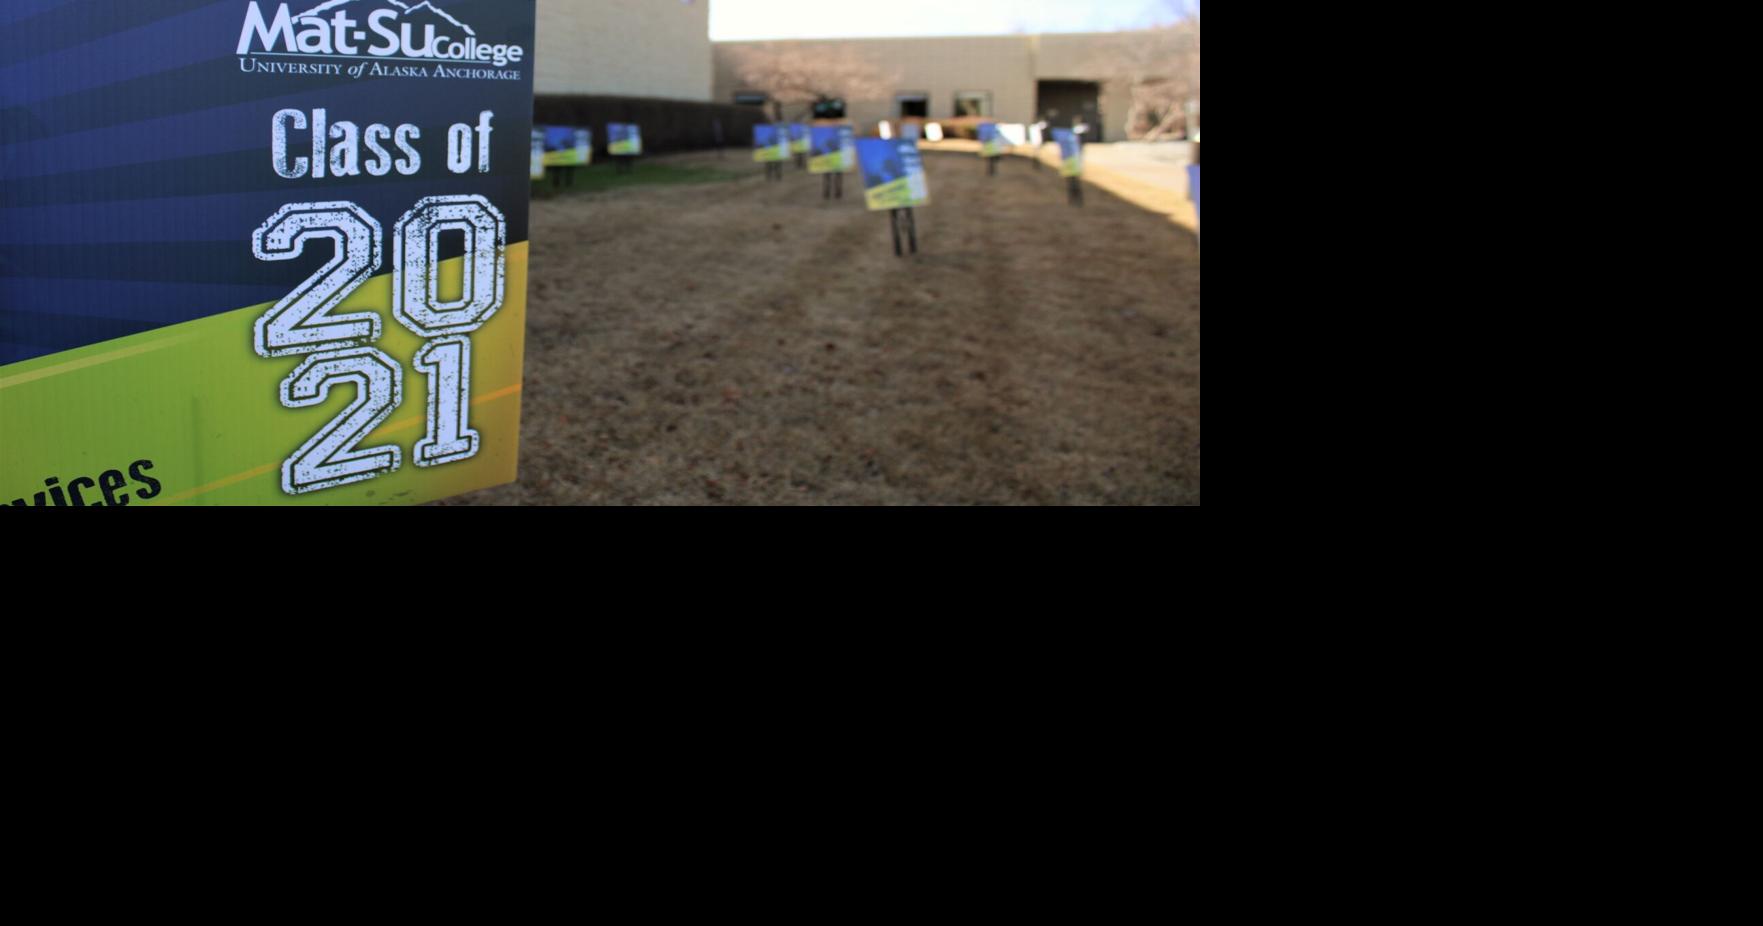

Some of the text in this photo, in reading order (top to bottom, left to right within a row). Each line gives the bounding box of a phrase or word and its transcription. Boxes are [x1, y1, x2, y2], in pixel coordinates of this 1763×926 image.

[239, 57, 521, 80] UNIVERSITY of ALASKA ANCHORAGE
[271, 108, 421, 179] Class
[447, 110, 494, 173] of
[252, 194, 506, 358] 20
[279, 334, 480, 494] 21
